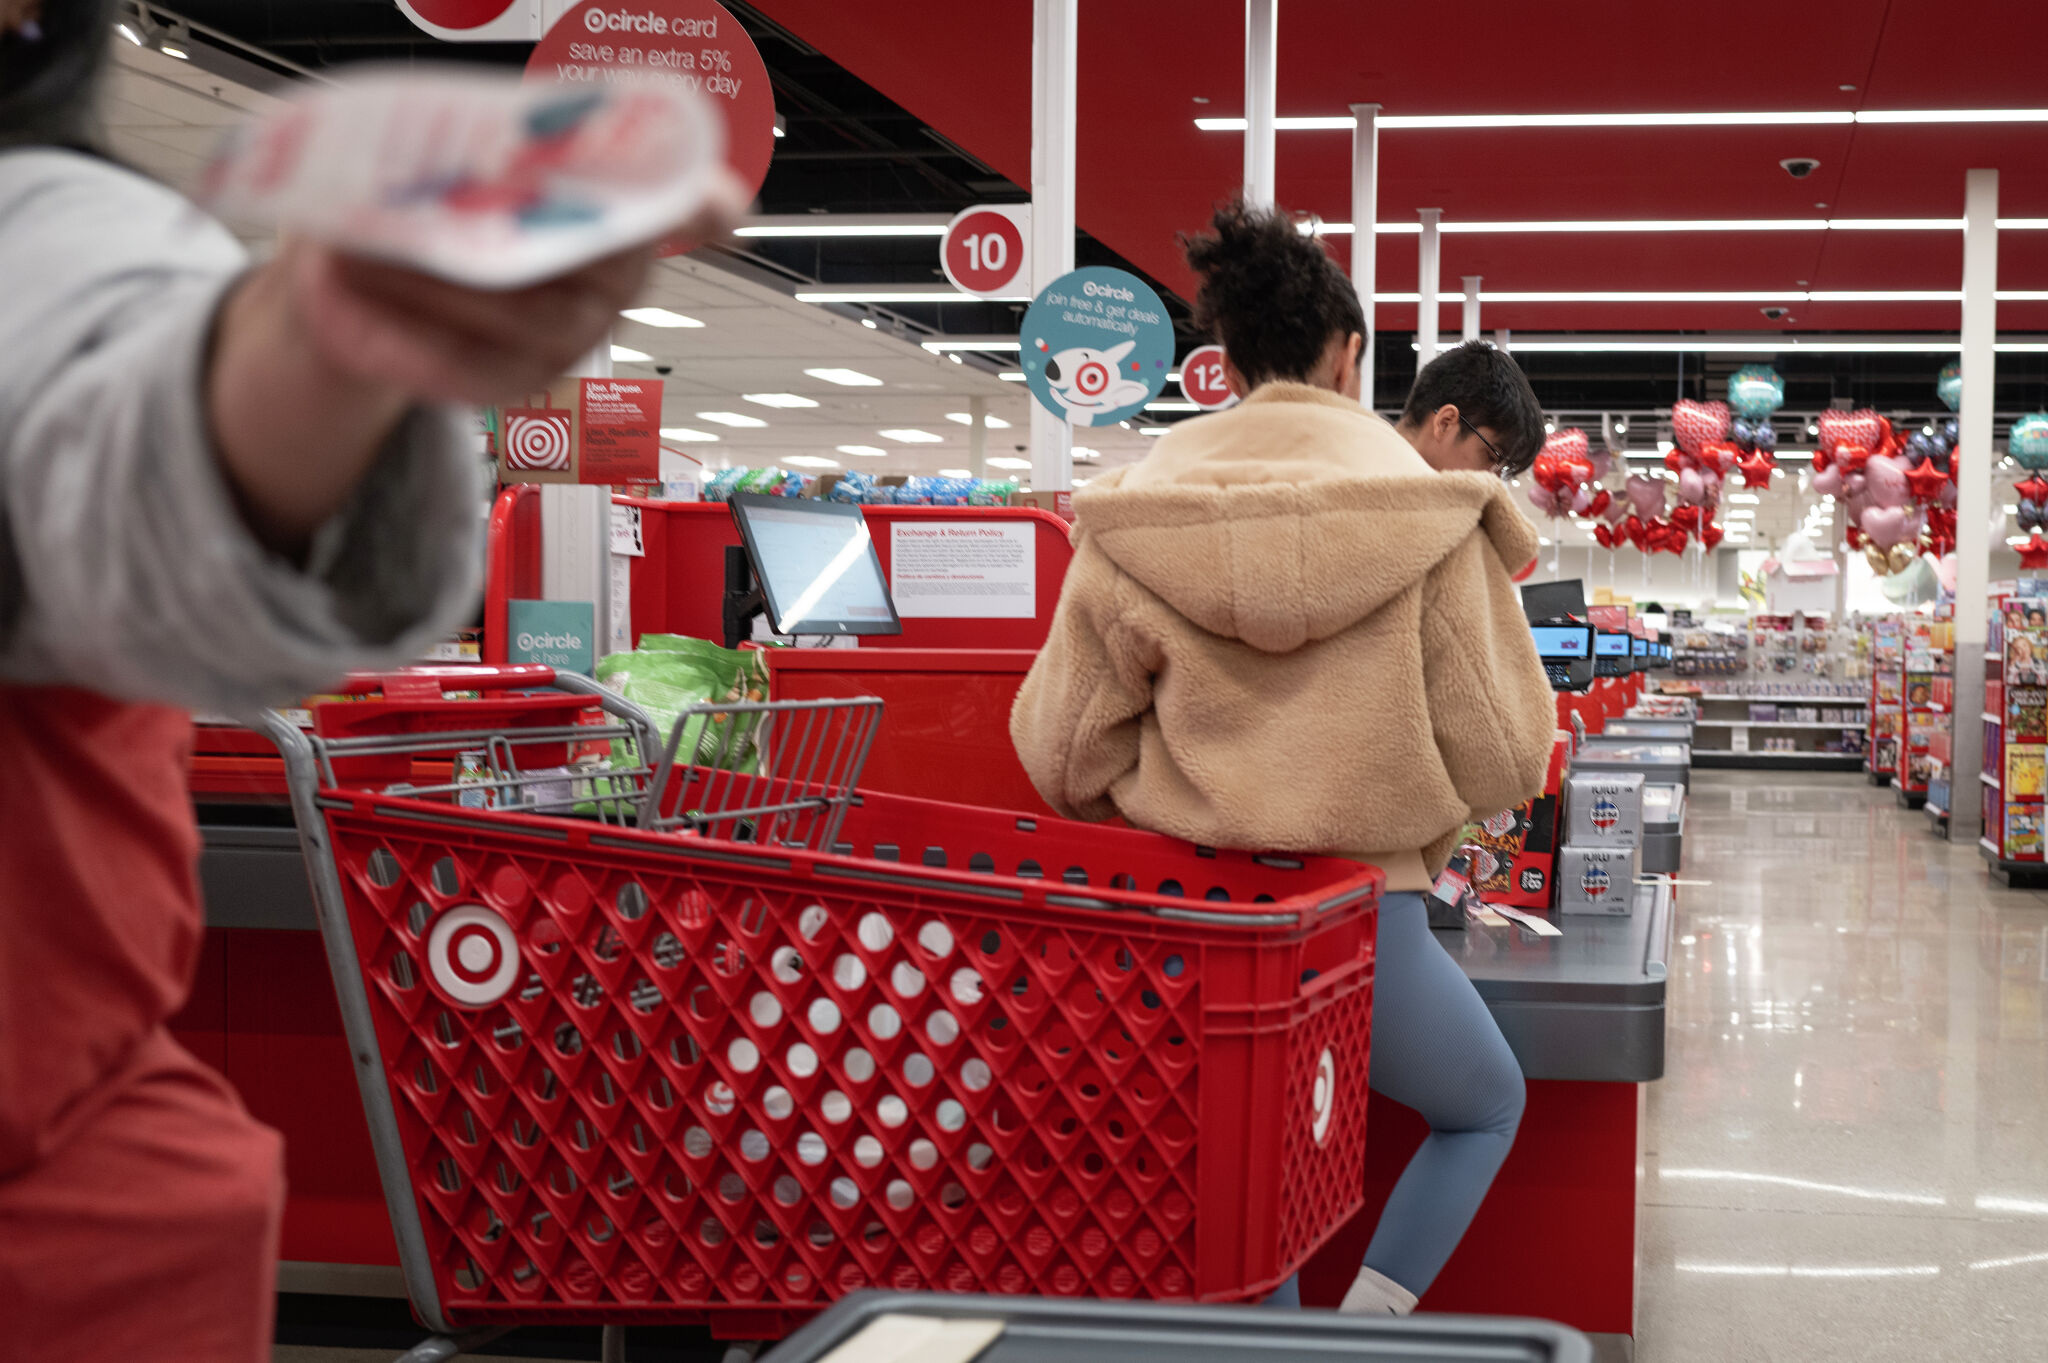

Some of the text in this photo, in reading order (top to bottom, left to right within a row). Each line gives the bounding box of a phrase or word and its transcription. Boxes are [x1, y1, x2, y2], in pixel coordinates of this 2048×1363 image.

[606, 8, 718, 39] circle card
[568, 42, 732, 73] save an extra 5%
[556, 63, 600, 85] your
[705, 72, 743, 100] day
[962, 232, 1008, 271] 10
[1097, 283, 1135, 303] circle
[1045, 290, 1161, 326] join free & get deals
[1062, 310, 1140, 337] automatically
[1193, 363, 1228, 392] 12
[896, 528, 1005, 539] Exchange & Return Policy
[534, 632, 582, 650] circle
[530, 651, 570, 665] is here
[1528, 871, 1544, 891] 18
